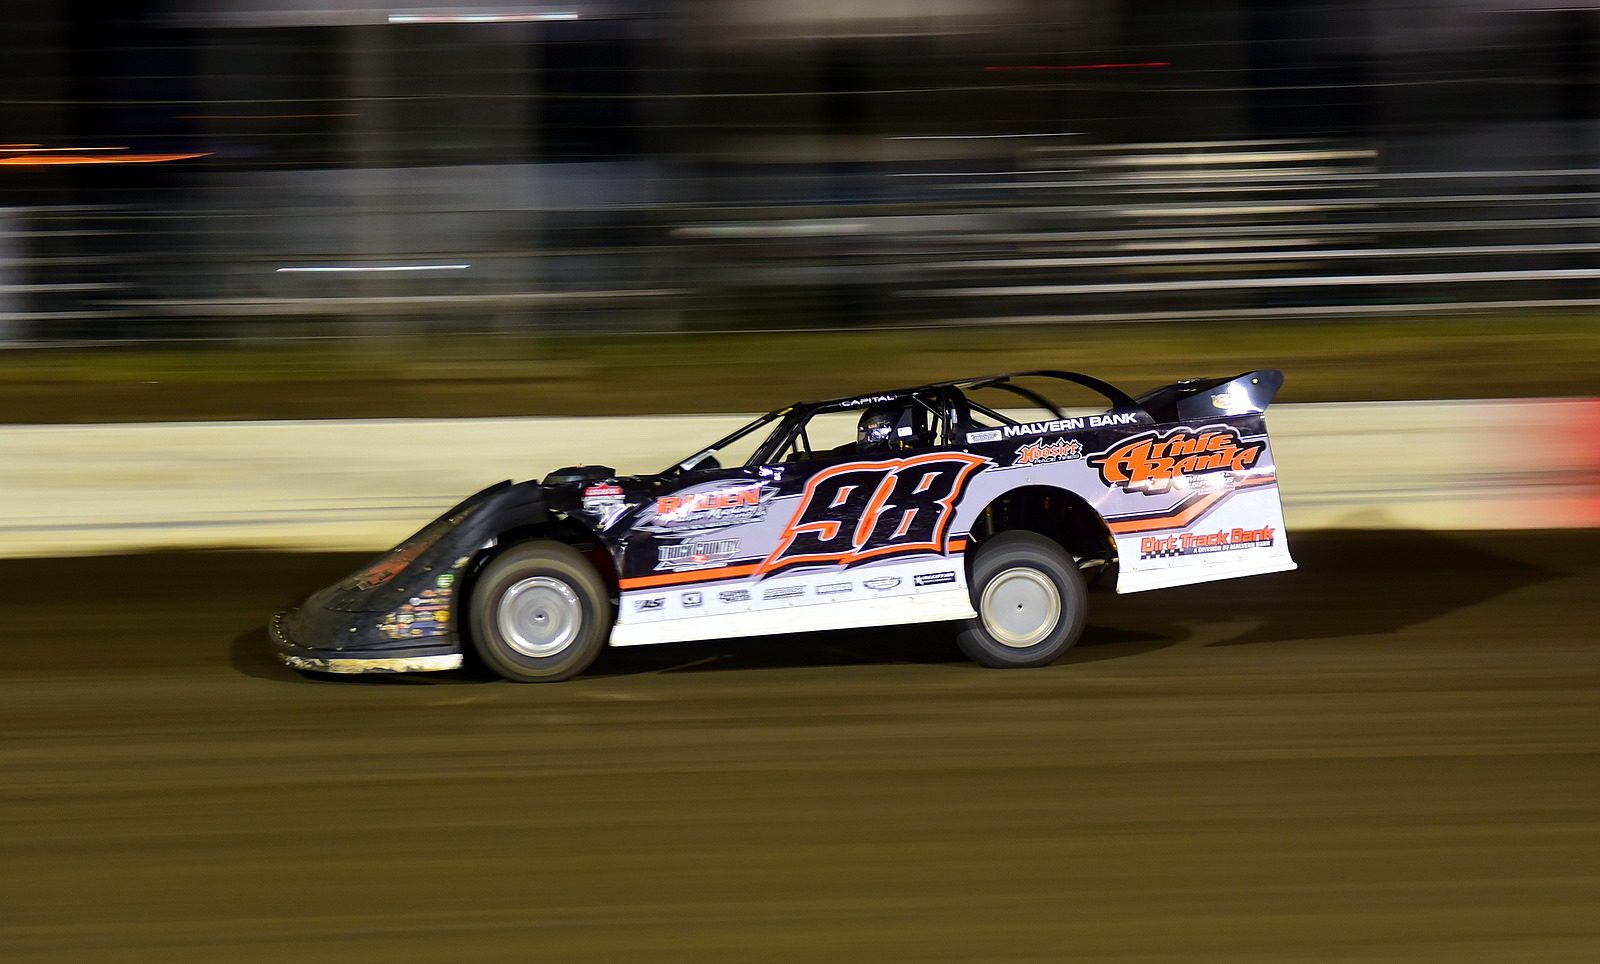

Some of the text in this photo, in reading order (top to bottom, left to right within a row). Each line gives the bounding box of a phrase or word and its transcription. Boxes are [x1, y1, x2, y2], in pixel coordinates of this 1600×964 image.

[841, 395, 895, 407] CAPITAL
[1004, 418, 1084, 438] MALVERN
[1089, 412, 1138, 428] BANK
[1017, 442, 1080, 464] Hoosier
[757, 452, 990, 570] 98
[1141, 525, 1275, 553] Dirt Track Bank
